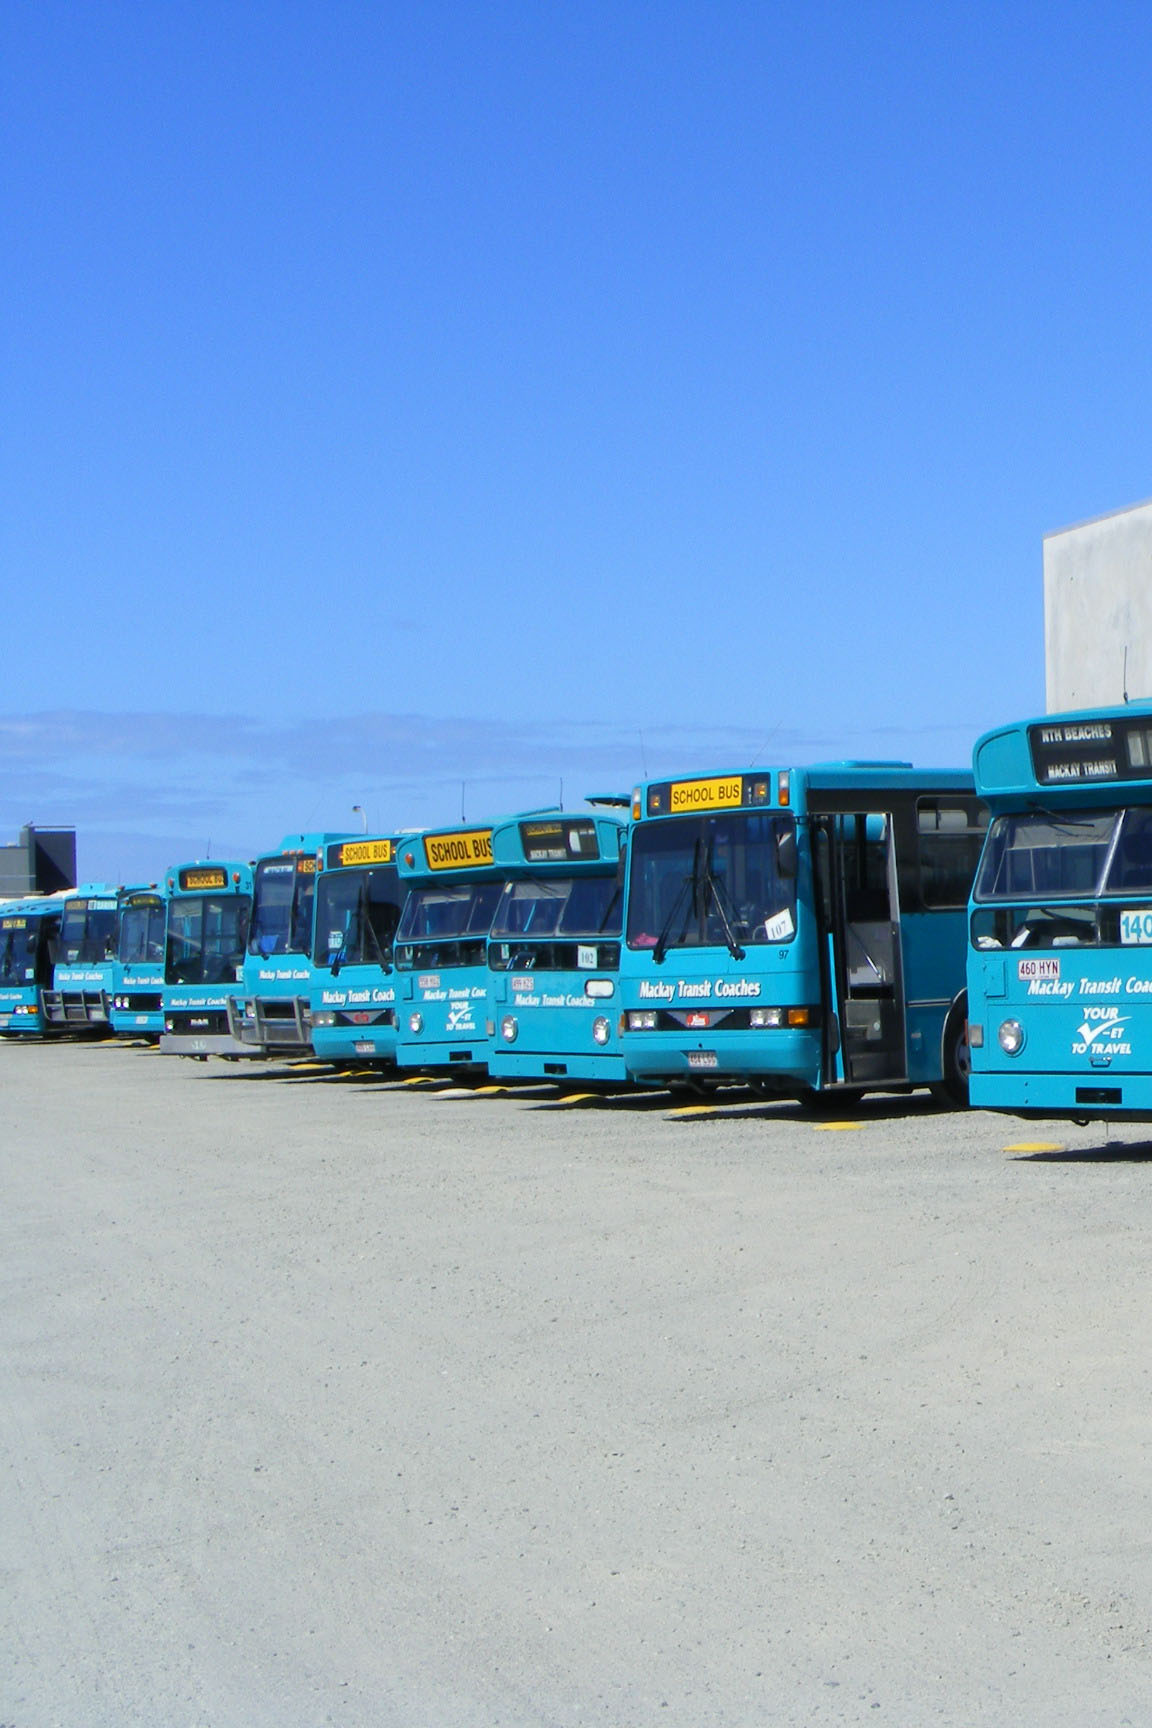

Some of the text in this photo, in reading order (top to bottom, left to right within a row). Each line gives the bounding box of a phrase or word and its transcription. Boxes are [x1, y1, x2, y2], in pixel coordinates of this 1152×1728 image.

[1042, 724, 1112, 743] NTH BEACHES
[1047, 760, 1118, 778] MACKAY TRANSIT
[673, 784, 740, 805] SCHOOL BUS
[344, 842, 388, 862] SCHOOL BUS
[430, 838, 493, 862] SCHOOL BUS
[770, 921, 788, 938] 107
[581, 952, 595, 964] 102
[778, 951, 788, 959] 97
[1020, 961, 1058, 975] 460 HYN
[423, 989, 447, 1001] Mackay
[448, 987, 470, 999] Transit
[640, 978, 761, 1001] Mackay Transit Coaches
[1027, 979, 1075, 999] Mackay
[1079, 977, 1122, 994] Transit
[322, 988, 395, 1007] Mackay Transit Coach
[514, 993, 595, 1007] Mackay Transit Coaches
[1083, 1007, 1119, 1020] YOUR
[1071, 1043, 1132, 1055] TO TRAVEL
